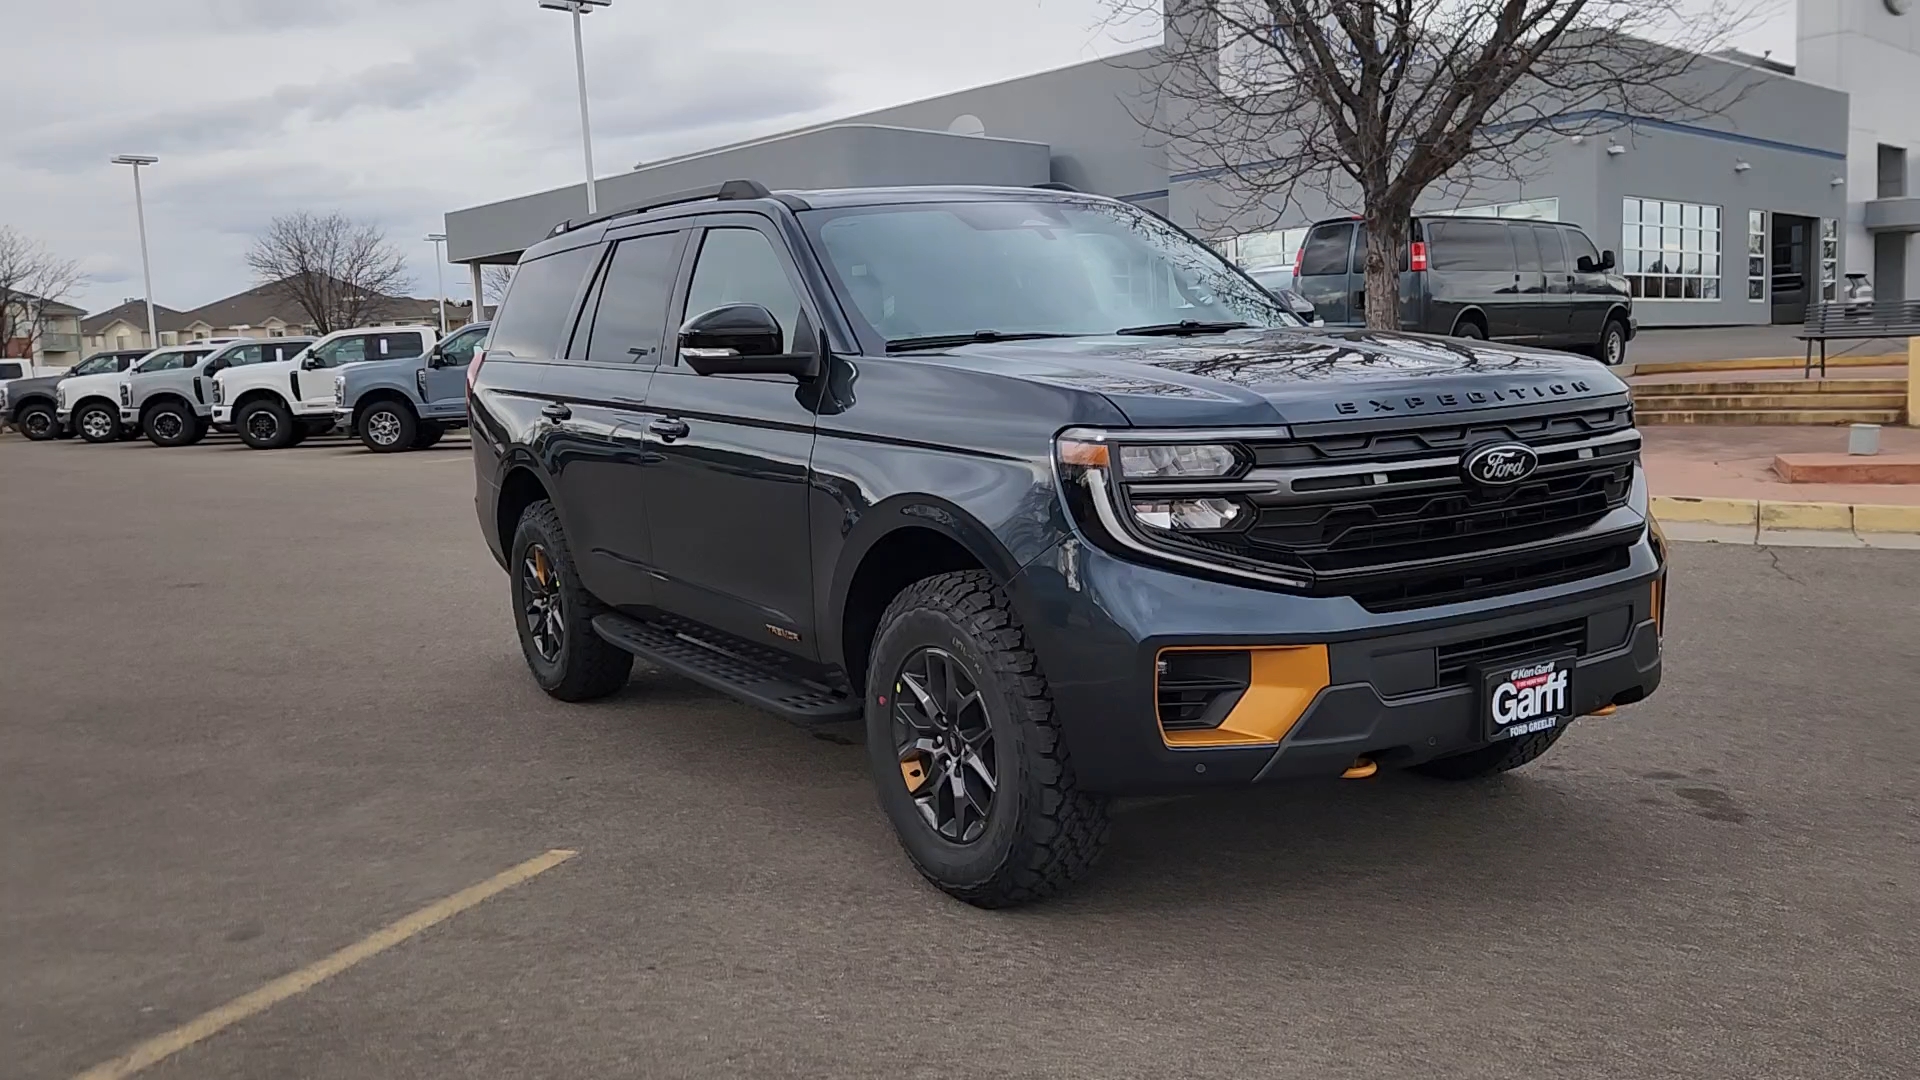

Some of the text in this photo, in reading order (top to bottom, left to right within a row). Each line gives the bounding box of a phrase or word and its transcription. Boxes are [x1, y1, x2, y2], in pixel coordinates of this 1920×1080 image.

[1335, 380, 1591, 415] EXPEDITION
[1483, 451, 1527, 478] Ford
[1518, 662, 1555, 680] Ken Garff
[1492, 669, 1568, 725] Garff
[1510, 716, 1557, 737] FORD GREELEY
